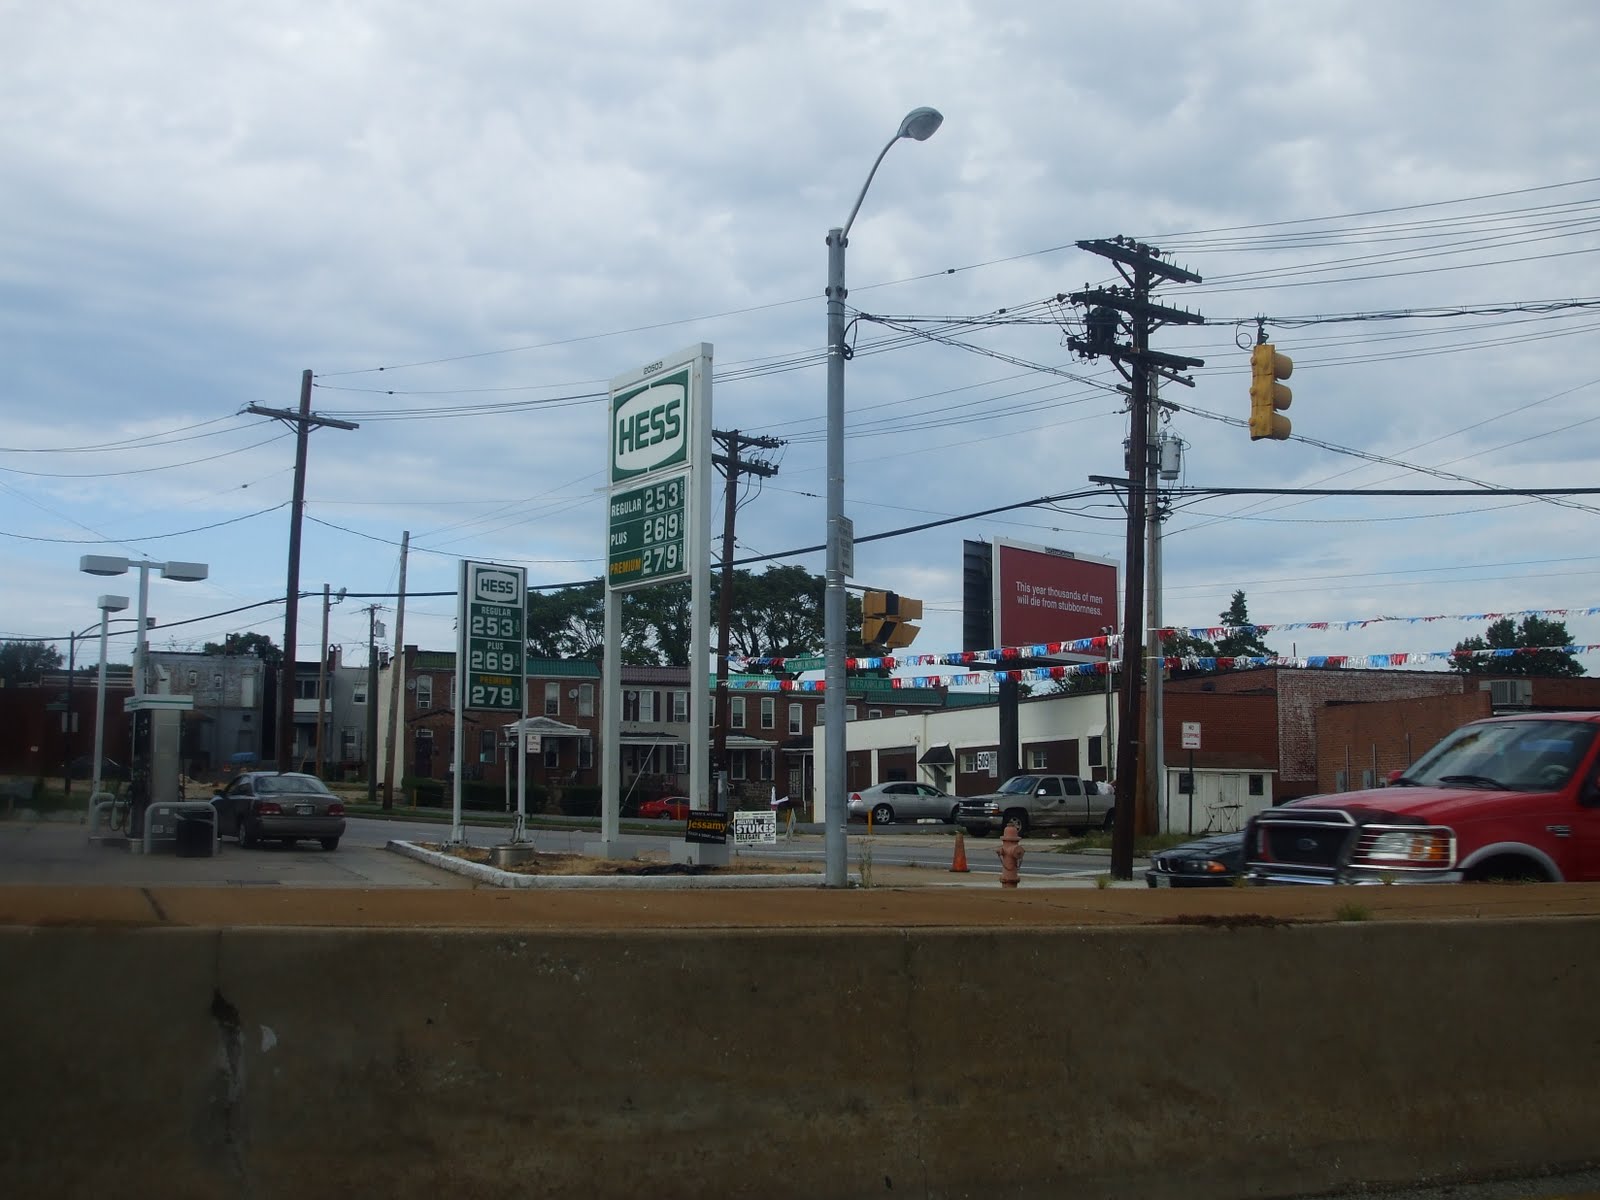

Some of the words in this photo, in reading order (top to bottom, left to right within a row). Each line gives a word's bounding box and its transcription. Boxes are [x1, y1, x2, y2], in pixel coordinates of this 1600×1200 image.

[619, 399, 681, 456] HESS
[611, 498, 642, 517] REGULAR
[645, 482, 679, 514] 253
[610, 532, 628, 547] PLUS
[643, 513, 679, 545] 269
[610, 558, 641, 575] PREMIUM
[642, 544, 678, 575] 279
[480, 578, 514, 595] HESS
[1016, 581, 1031, 593] This
[1032, 585, 1046, 596] year
[1048, 586, 1081, 601] thousands
[1081, 591, 1089, 601] of
[1089, 594, 1103, 604] men
[481, 606, 512, 617] REGULAR
[1017, 595, 1029, 605] will
[1030, 596, 1041, 607] die
[1042, 599, 1057, 609] from
[472, 615, 514, 637] 253
[487, 641, 504, 651] PLUS
[471, 650, 514, 672] 269
[479, 675, 512, 685] PREMIUM
[472, 685, 514, 706] 279
[687, 819, 726, 833] Jessamy
[736, 823, 775, 834] STUKES
